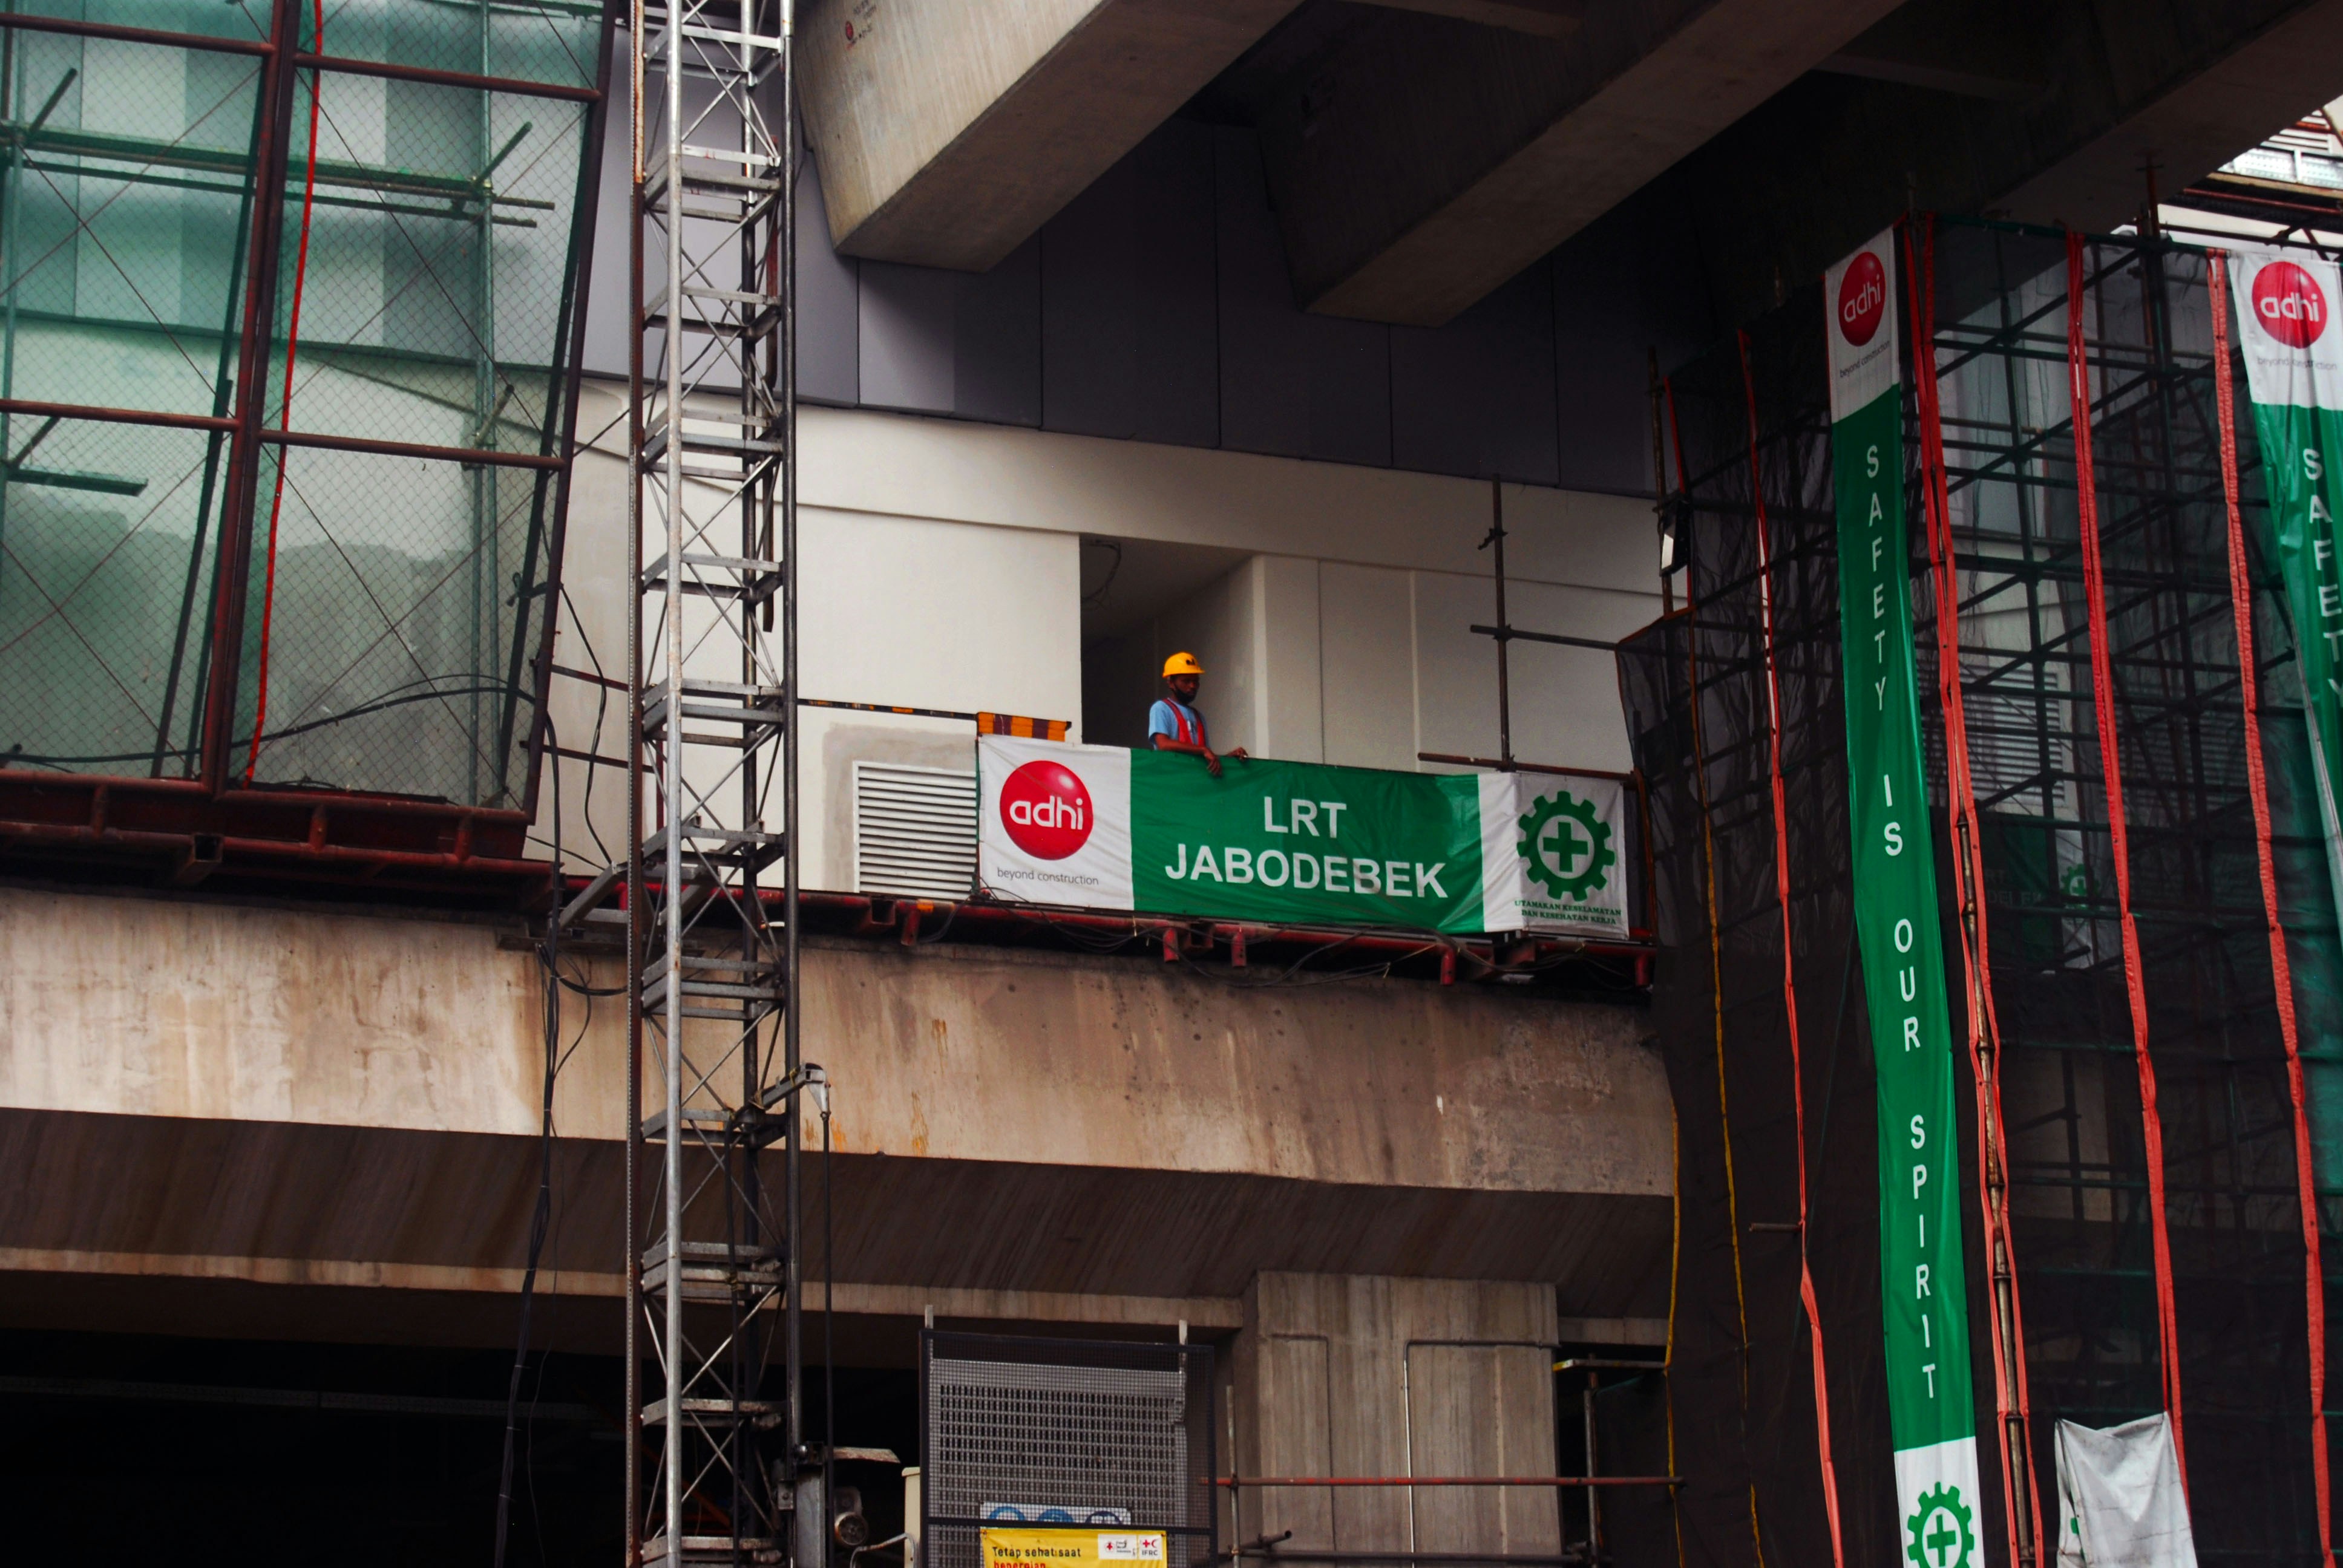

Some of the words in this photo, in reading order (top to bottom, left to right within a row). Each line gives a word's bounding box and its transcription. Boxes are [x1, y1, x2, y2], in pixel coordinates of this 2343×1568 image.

[1843, 273, 1881, 322] adhi
[2260, 292, 2320, 322] adhi
[1840, 358, 1861, 377] beyond
[1009, 795, 1083, 830] adhi
[1264, 797, 1347, 838] LRT
[997, 866, 1034, 881] beyond
[1037, 872, 1099, 885] construction
[1165, 844, 1449, 898] JABODEBEK
[1515, 900, 1561, 910] UTAMAKAN
[1562, 904, 1622, 916] KESELAMATAN
[1540, 912, 1588, 921] KESEHATAN
[1591, 916, 1616, 925] KERJA
[1866, 445, 1886, 711] SAFETY
[1883, 774, 1903, 857] IS
[1893, 918, 1921, 1053] OUR
[1910, 1114, 1936, 1399] SPIRIT
[992, 1546, 1021, 1558] Tetap
[1025, 1547, 1054, 1557] sehat
[1058, 1547, 1081, 1557] saat
